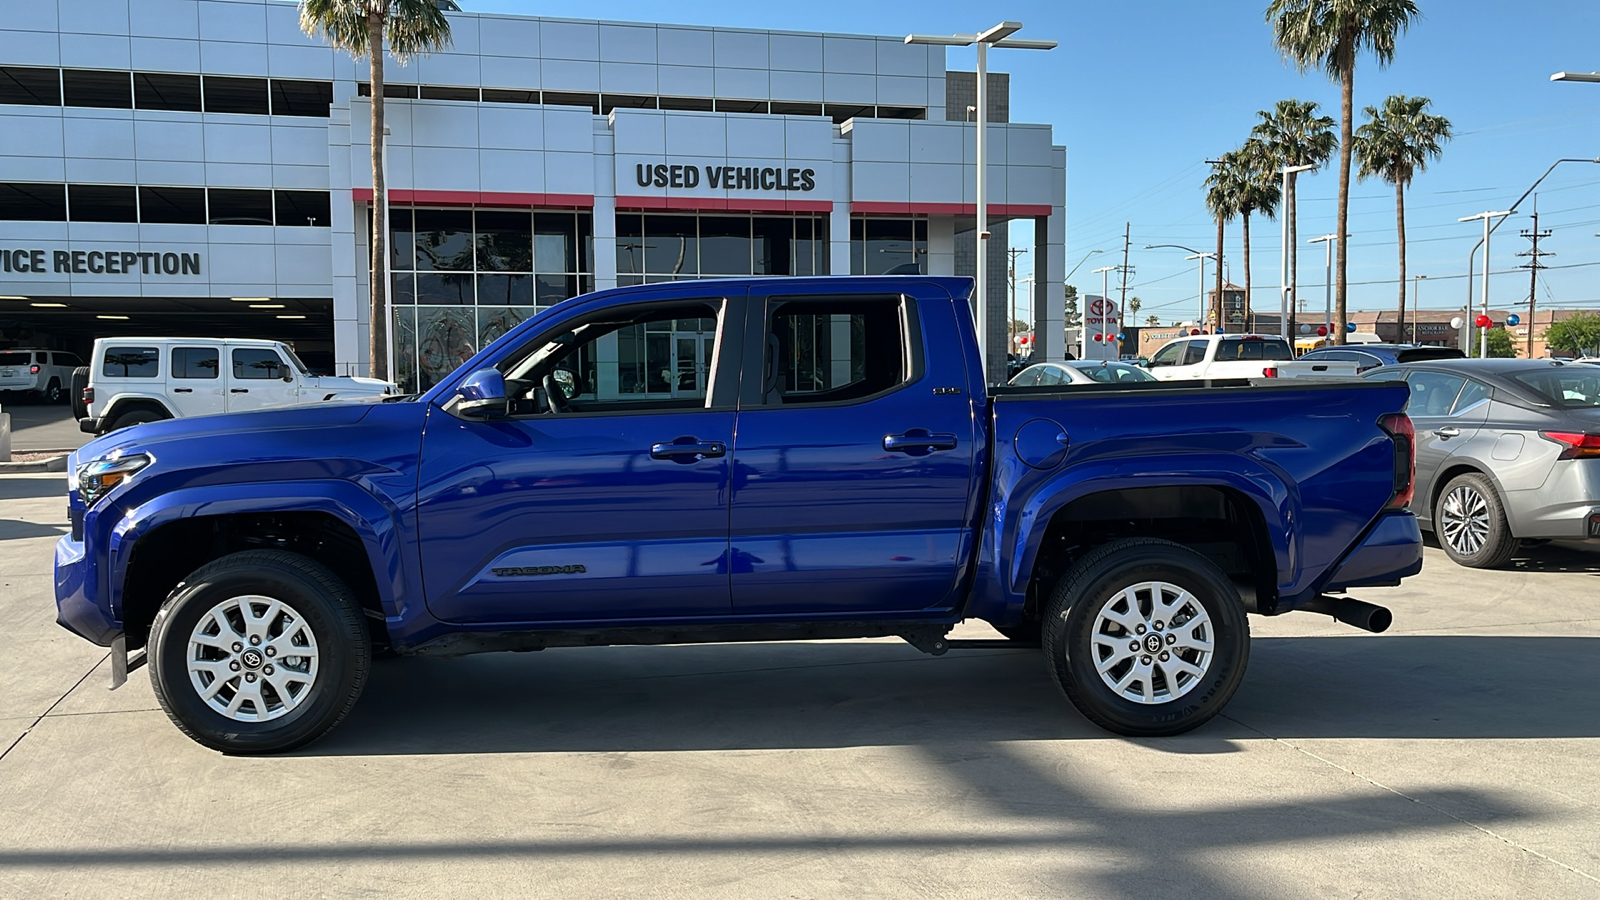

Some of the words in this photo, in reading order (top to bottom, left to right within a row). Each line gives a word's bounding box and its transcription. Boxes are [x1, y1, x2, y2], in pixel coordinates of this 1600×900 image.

[636, 163, 700, 188] USED
[706, 166, 815, 191] VEHICLES
[0, 249, 47, 273] ICE
[53, 250, 200, 275] RECEPTION
[1086, 317, 1118, 325] TOYTA
[491, 564, 587, 577] TACOMA
